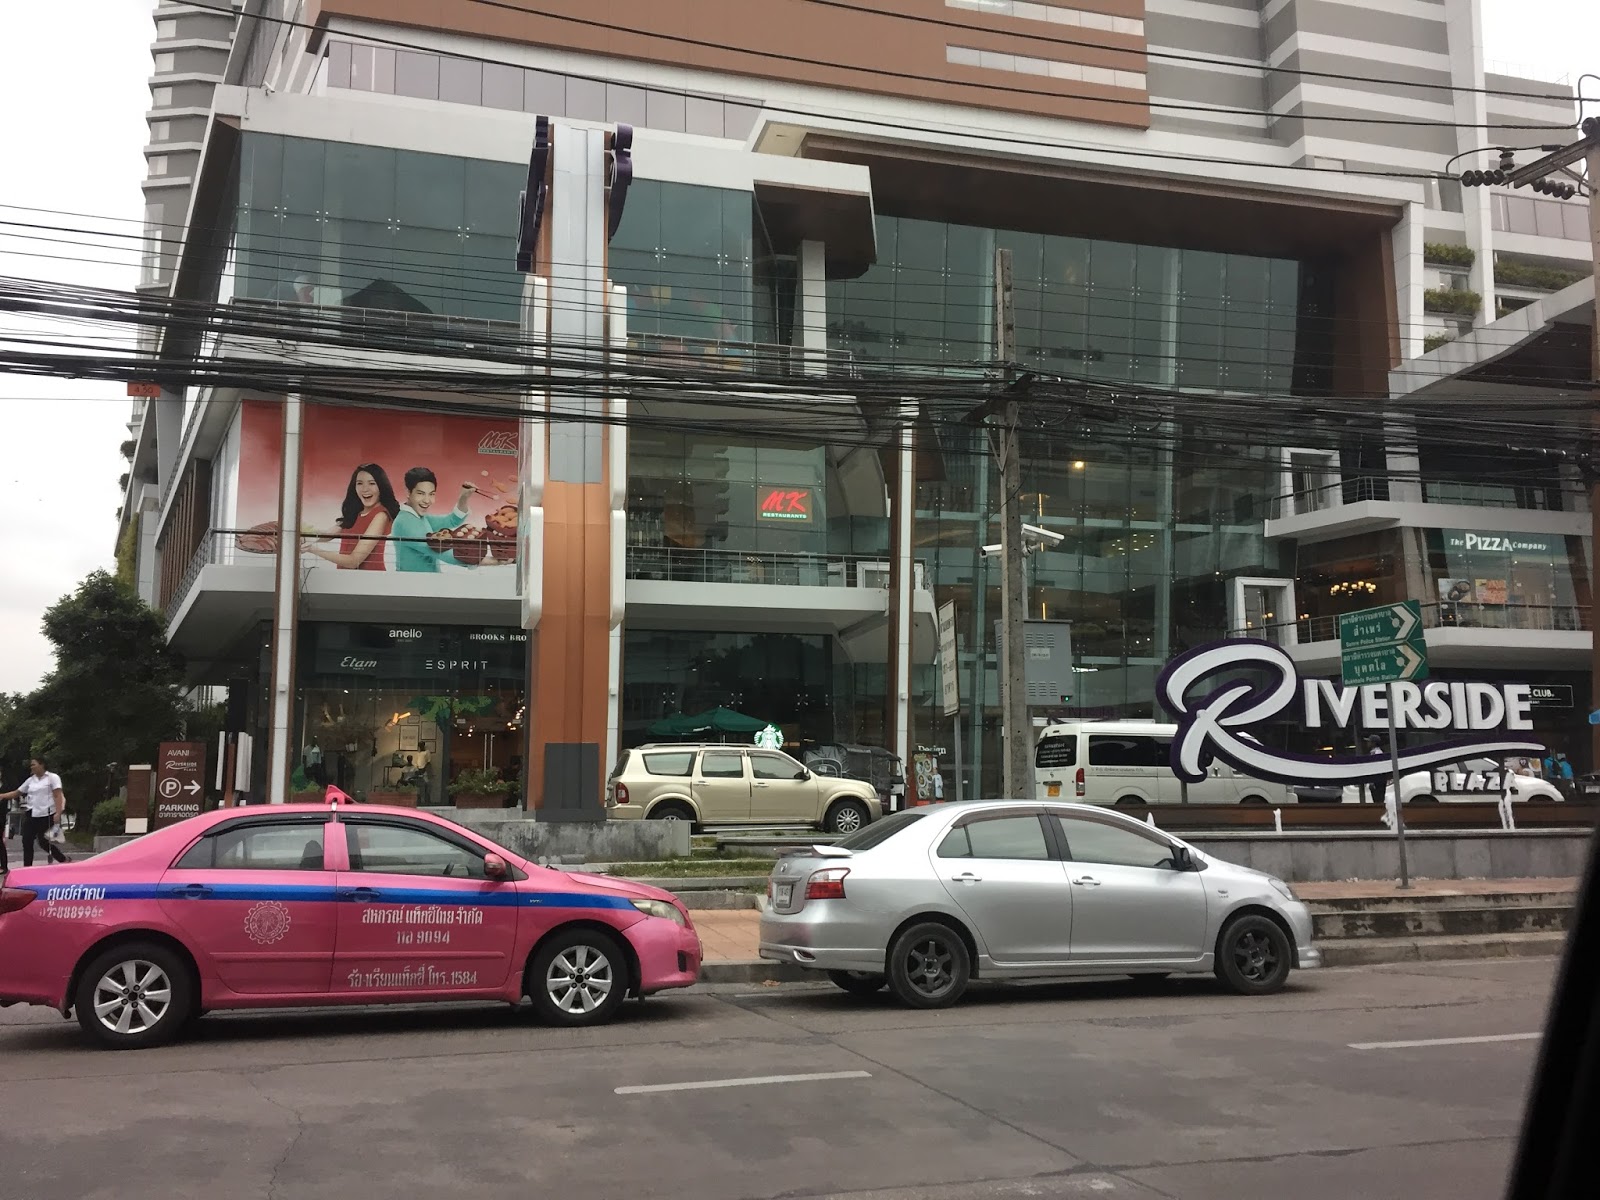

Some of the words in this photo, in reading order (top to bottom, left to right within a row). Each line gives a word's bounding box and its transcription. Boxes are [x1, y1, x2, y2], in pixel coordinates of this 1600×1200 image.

[478, 430, 519, 450] MK
[761, 490, 808, 513] MK
[1450, 538, 1464, 546] The
[1465, 533, 1513, 552] PIZZA
[1513, 541, 1547, 551] Company
[388, 628, 422, 639] anello
[469, 633, 505, 641] BROOKS
[340, 656, 377, 668] Etam
[425, 659, 489, 670] ESPRIT
[1164, 641, 1536, 779] RIVERSIDE
[167, 749, 190, 757] AVANI
[1433, 770, 1519, 793] PLAZA
[158, 804, 200, 812] PARKING
[362, 905, 404, 924] สหกรณ์
[456, 907, 483, 924] จำกัด
